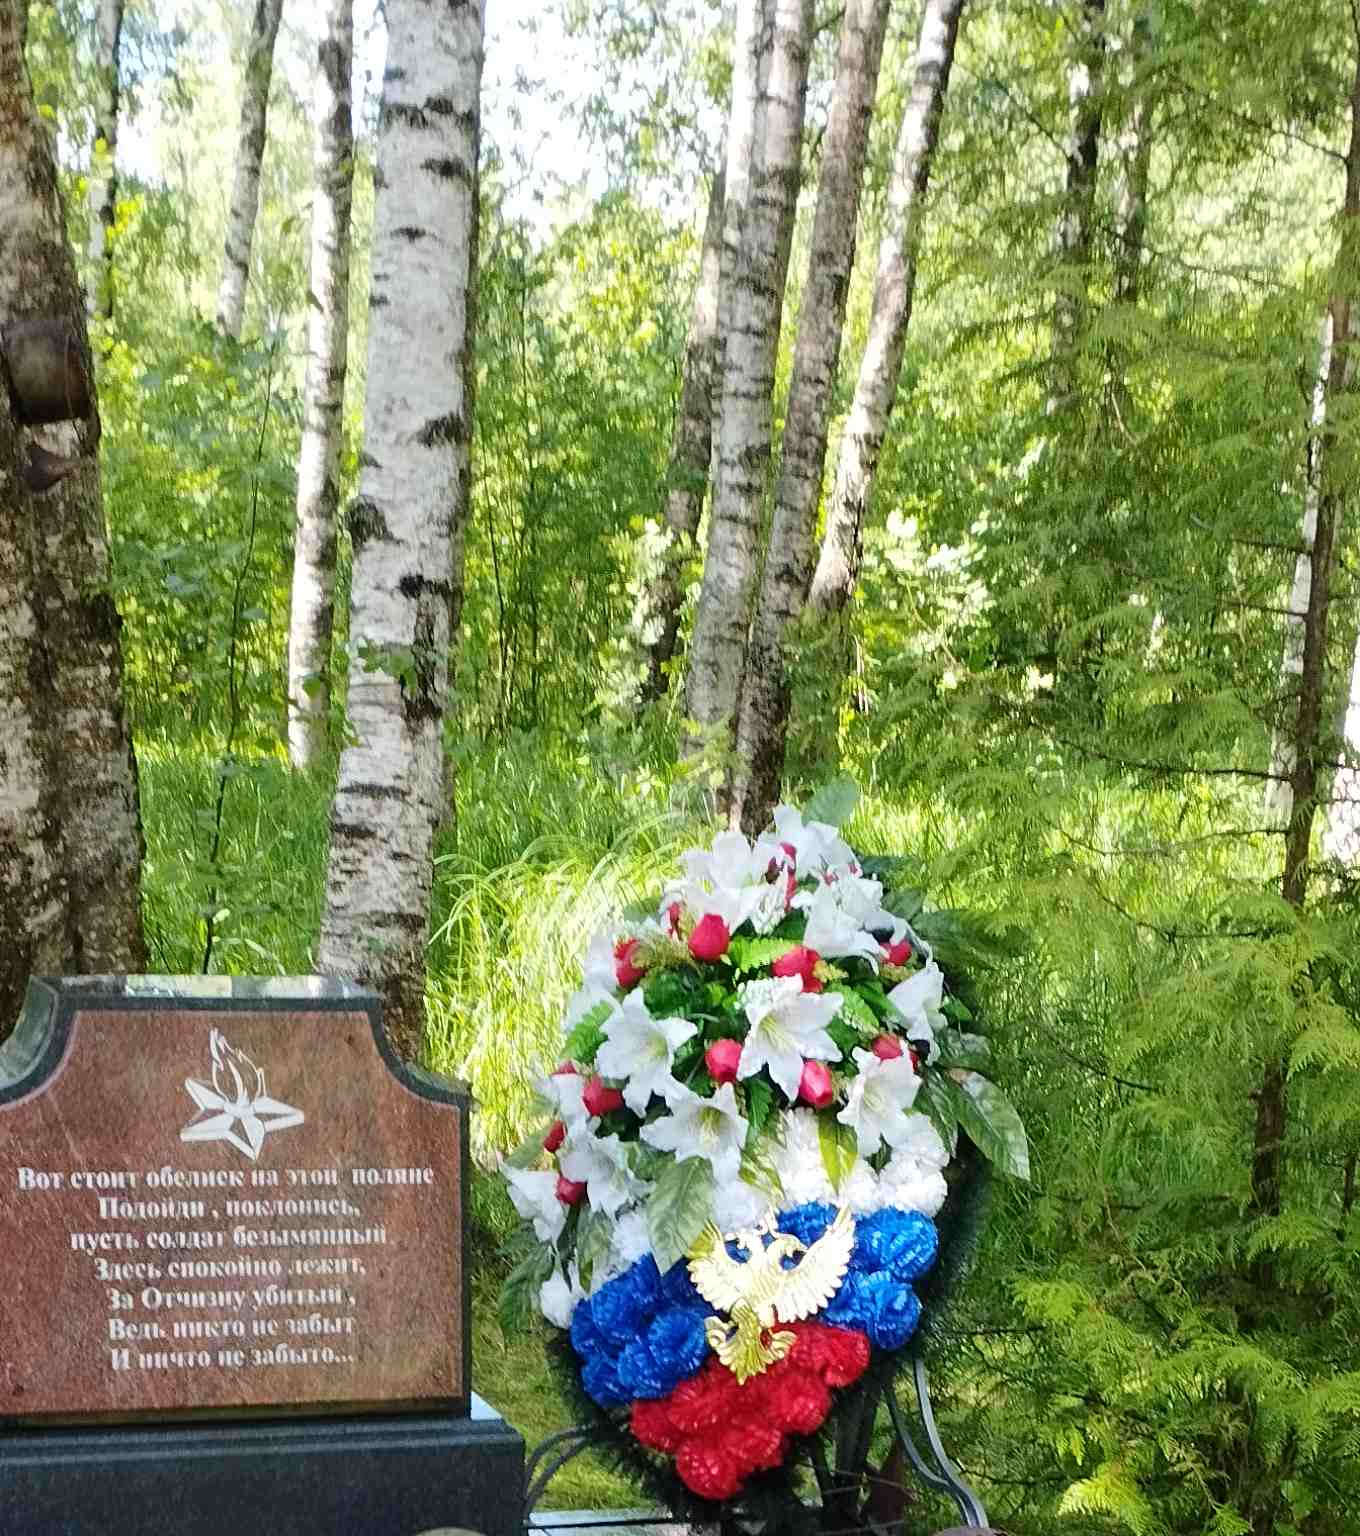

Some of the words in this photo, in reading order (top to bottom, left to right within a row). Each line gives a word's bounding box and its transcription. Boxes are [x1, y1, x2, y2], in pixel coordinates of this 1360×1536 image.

[17, 1167, 63, 1190] Вот
[70, 1169, 137, 1189] стоит
[146, 1165, 245, 1188] обелиск
[252, 1169, 279, 1186] на
[352, 1167, 434, 1186] поляне
[71, 1232, 140, 1257] пусть
[146, 1230, 224, 1249] солдат
[233, 1224, 386, 1247] безымянный
[94, 1257, 162, 1281] Здесь
[167, 1256, 282, 1278] спокойно
[107, 1288, 134, 1311] За
[142, 1286, 247, 1313] Отчизну
[108, 1317, 167, 1341] Ведь
[173, 1319, 245, 1338] никто
[252, 1320, 279, 1336] не
[286, 1312, 354, 1335] забыт
[111, 1347, 131, 1371] И
[138, 1348, 211, 1370] ничто
[218, 1349, 246, 1366] не
